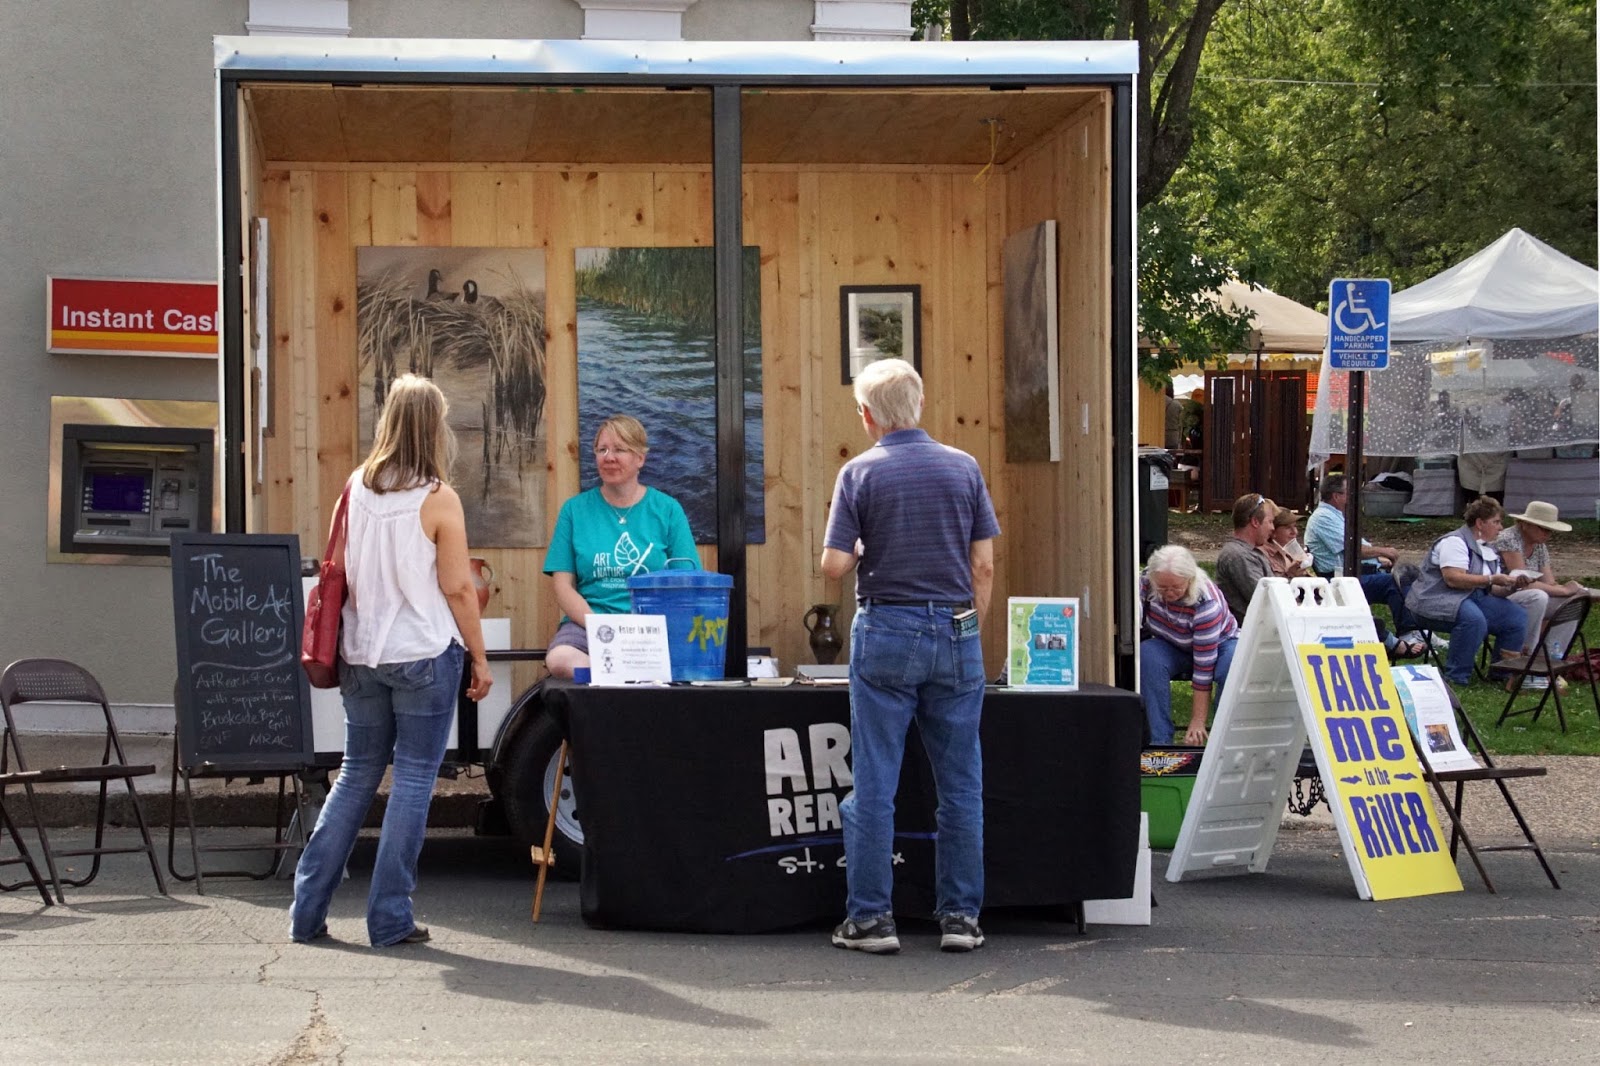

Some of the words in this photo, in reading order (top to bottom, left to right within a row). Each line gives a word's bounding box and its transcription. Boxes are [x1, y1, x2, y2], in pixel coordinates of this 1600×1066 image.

[62, 305, 154, 329] Instant
[190, 553, 242, 582] The
[592, 552, 611, 566] ART
[597, 566, 625, 578] NATURE
[190, 585, 262, 614] Mobile
[260, 584, 291, 623] Art
[201, 617, 287, 657] Gallery
[688, 615, 729, 652] ART
[1307, 654, 1390, 712] TAKE
[232, 692, 268, 709] support
[259, 708, 283, 721] Bar
[1325, 717, 1405, 762] me
[763, 722, 854, 795] AR
[1364, 767, 1376, 786] to
[1374, 766, 1391, 785] the
[767, 792, 842, 837] REA
